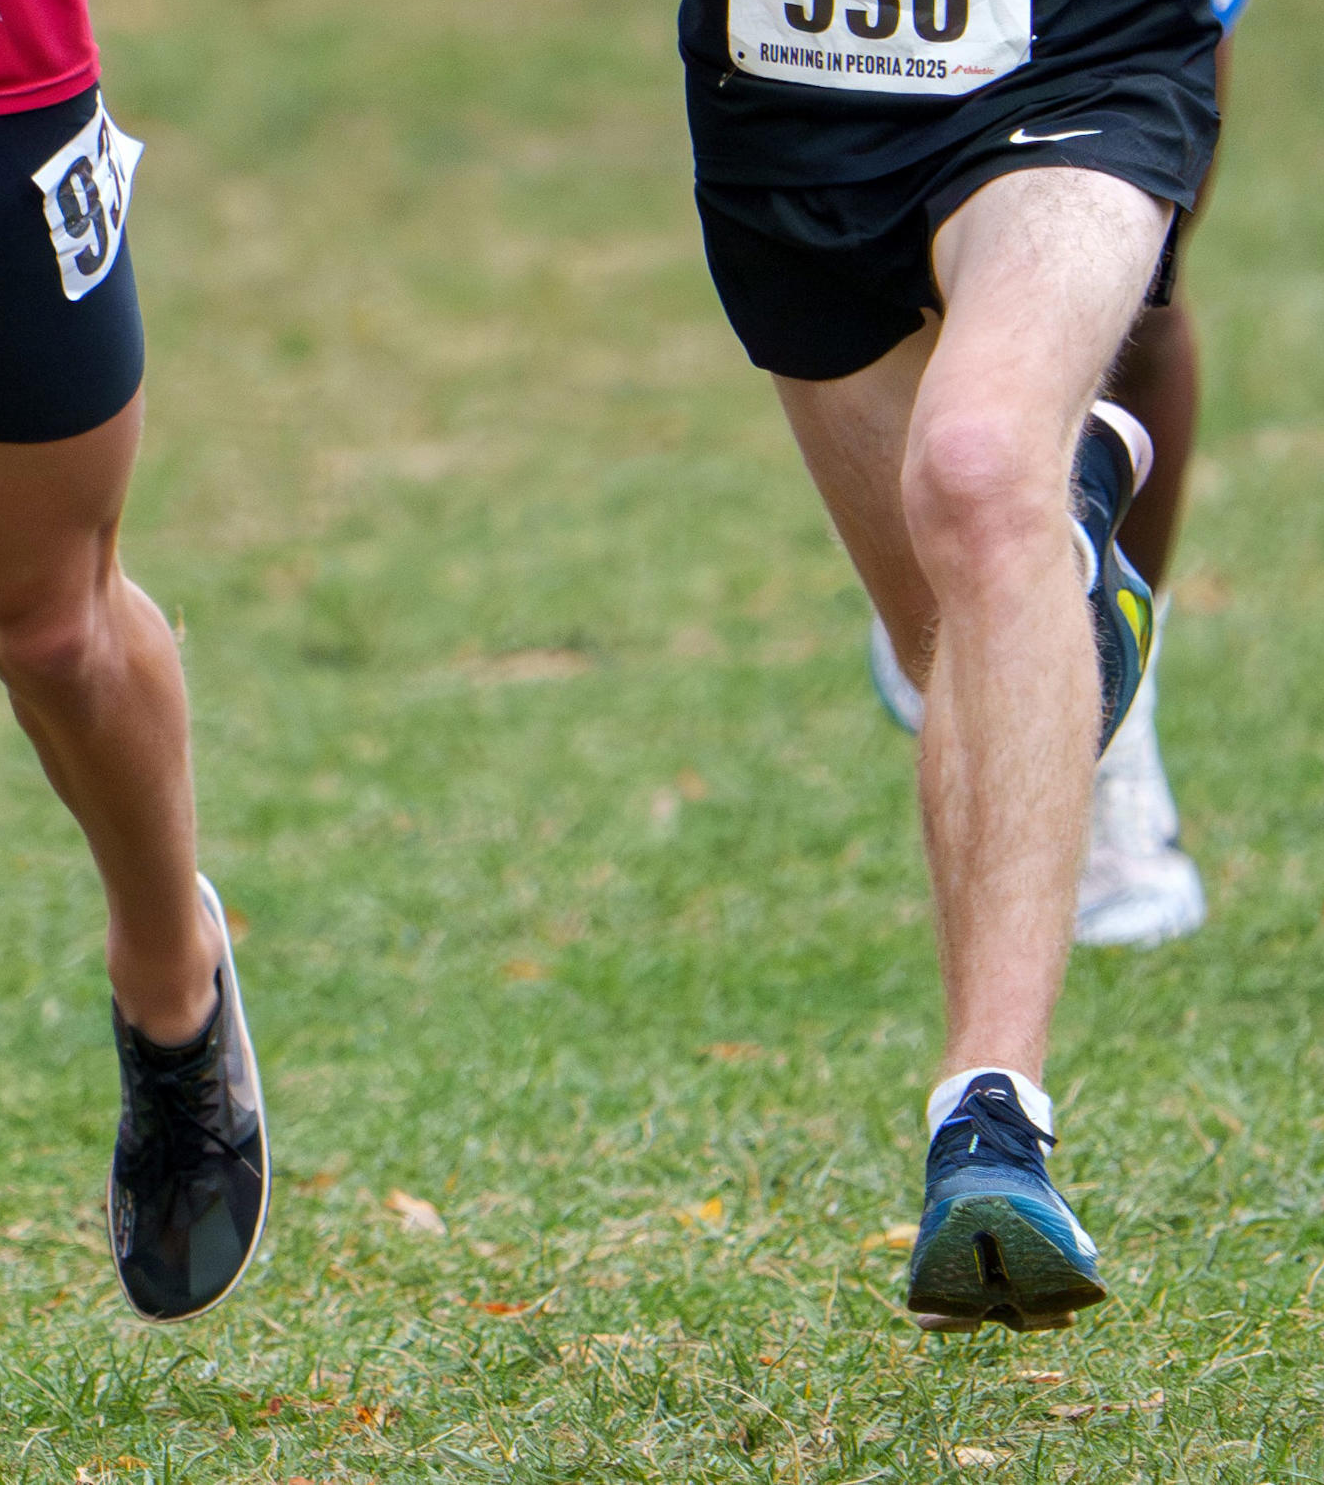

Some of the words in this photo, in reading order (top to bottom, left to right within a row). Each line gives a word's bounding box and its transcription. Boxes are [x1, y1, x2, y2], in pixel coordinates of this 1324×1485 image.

[759, 42, 824, 70] RUNNING
[826, 52, 842, 72] IN
[846, 54, 902, 77] PEORIA
[905, 57, 947, 80] 2025
